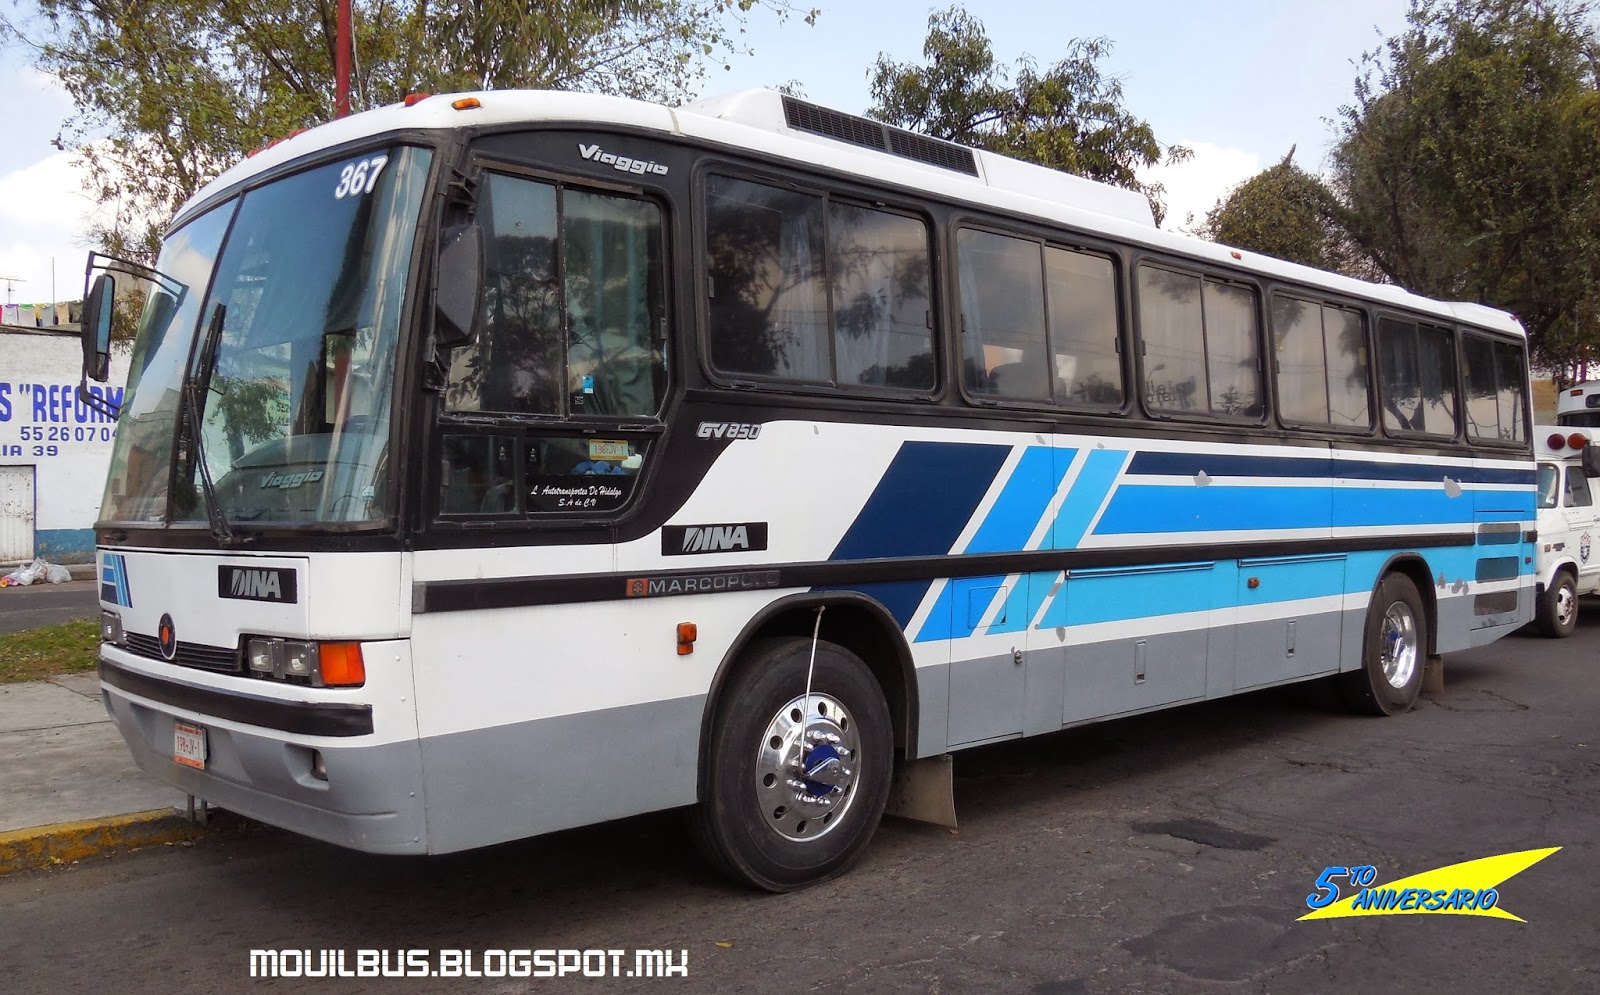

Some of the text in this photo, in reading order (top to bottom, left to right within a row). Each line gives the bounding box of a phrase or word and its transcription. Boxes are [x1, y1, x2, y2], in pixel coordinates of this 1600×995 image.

[579, 143, 669, 176] Viaggio
[335, 155, 388, 200] 367
[0, 444, 58, 456] IA 39
[260, 469, 325, 489] Viaggio
[541, 484, 588, 498] Autotransportes
[598, 485, 622, 499] Hidalgo
[681, 525, 750, 552] DINA
[230, 568, 282, 599] DINA
